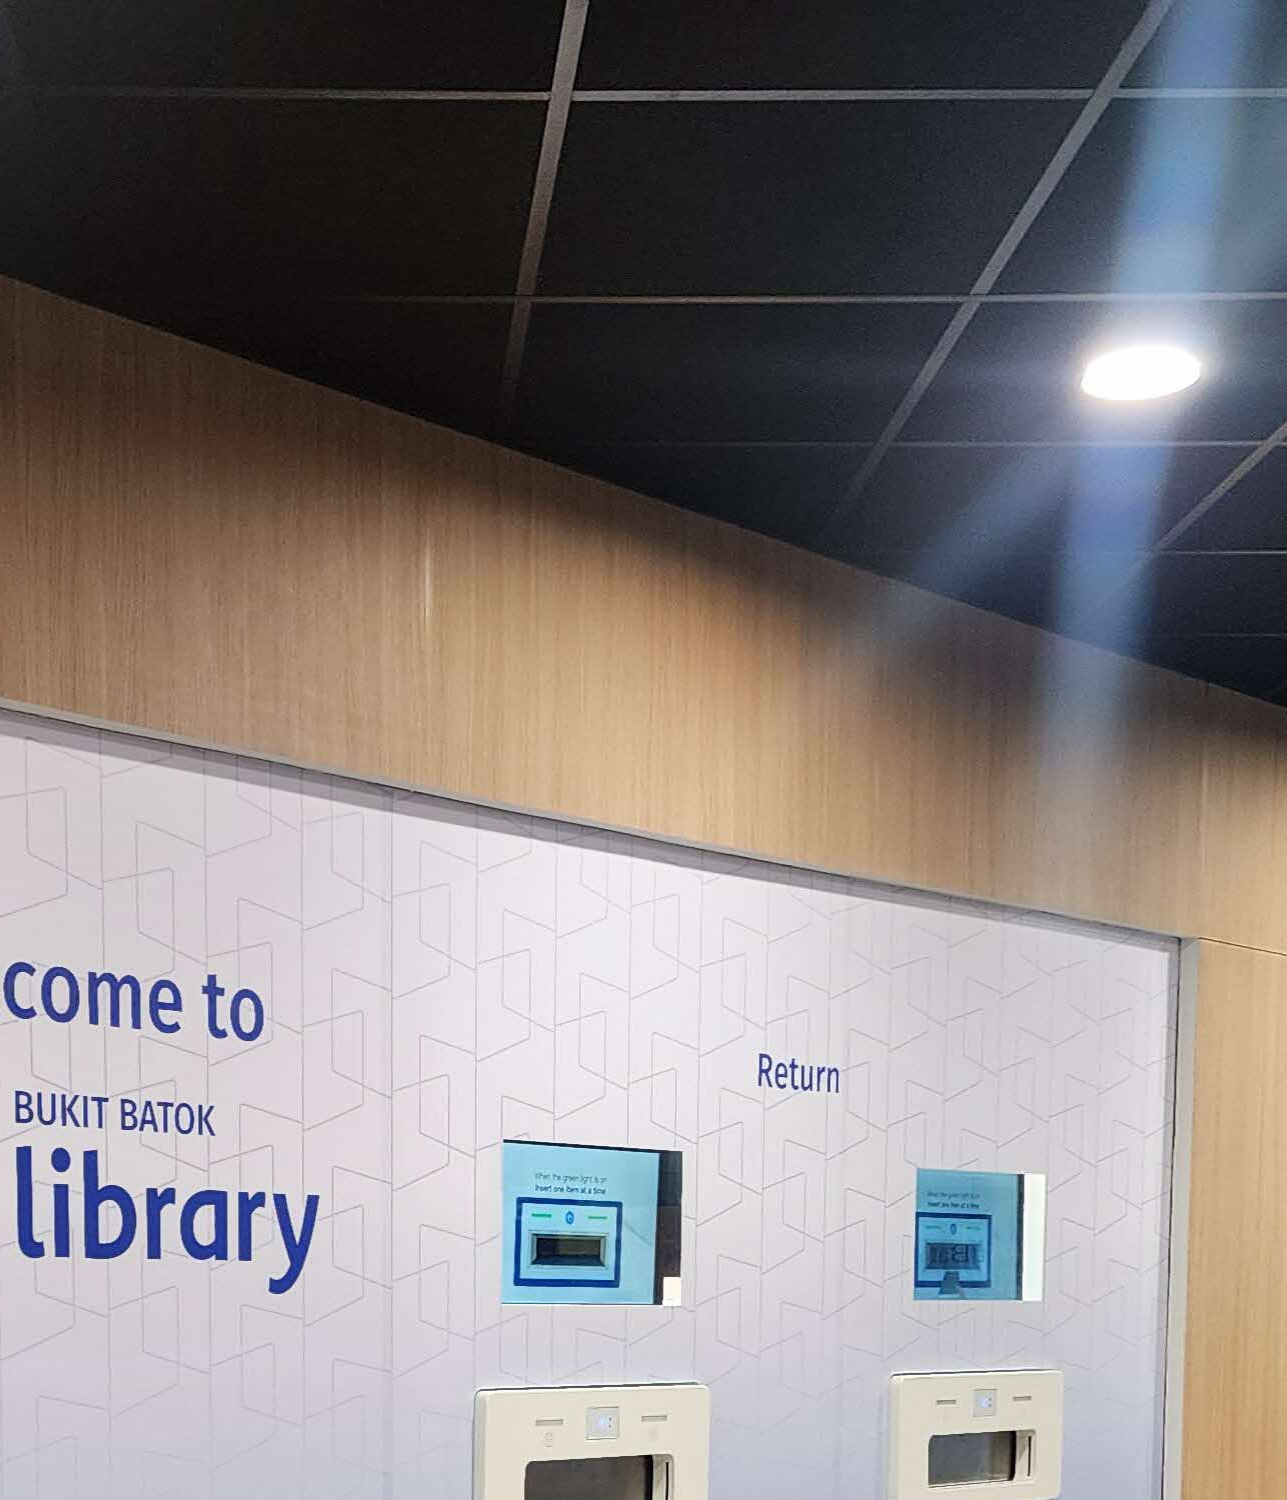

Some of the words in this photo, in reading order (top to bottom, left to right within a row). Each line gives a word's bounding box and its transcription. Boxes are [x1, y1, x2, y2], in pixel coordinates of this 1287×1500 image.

[202, 974, 265, 1042] to
[757, 1053, 840, 1093] Return
[14, 1090, 108, 1130] BUKIT
[121, 1098, 216, 1137] BATOK
[16, 1145, 320, 1295] library
